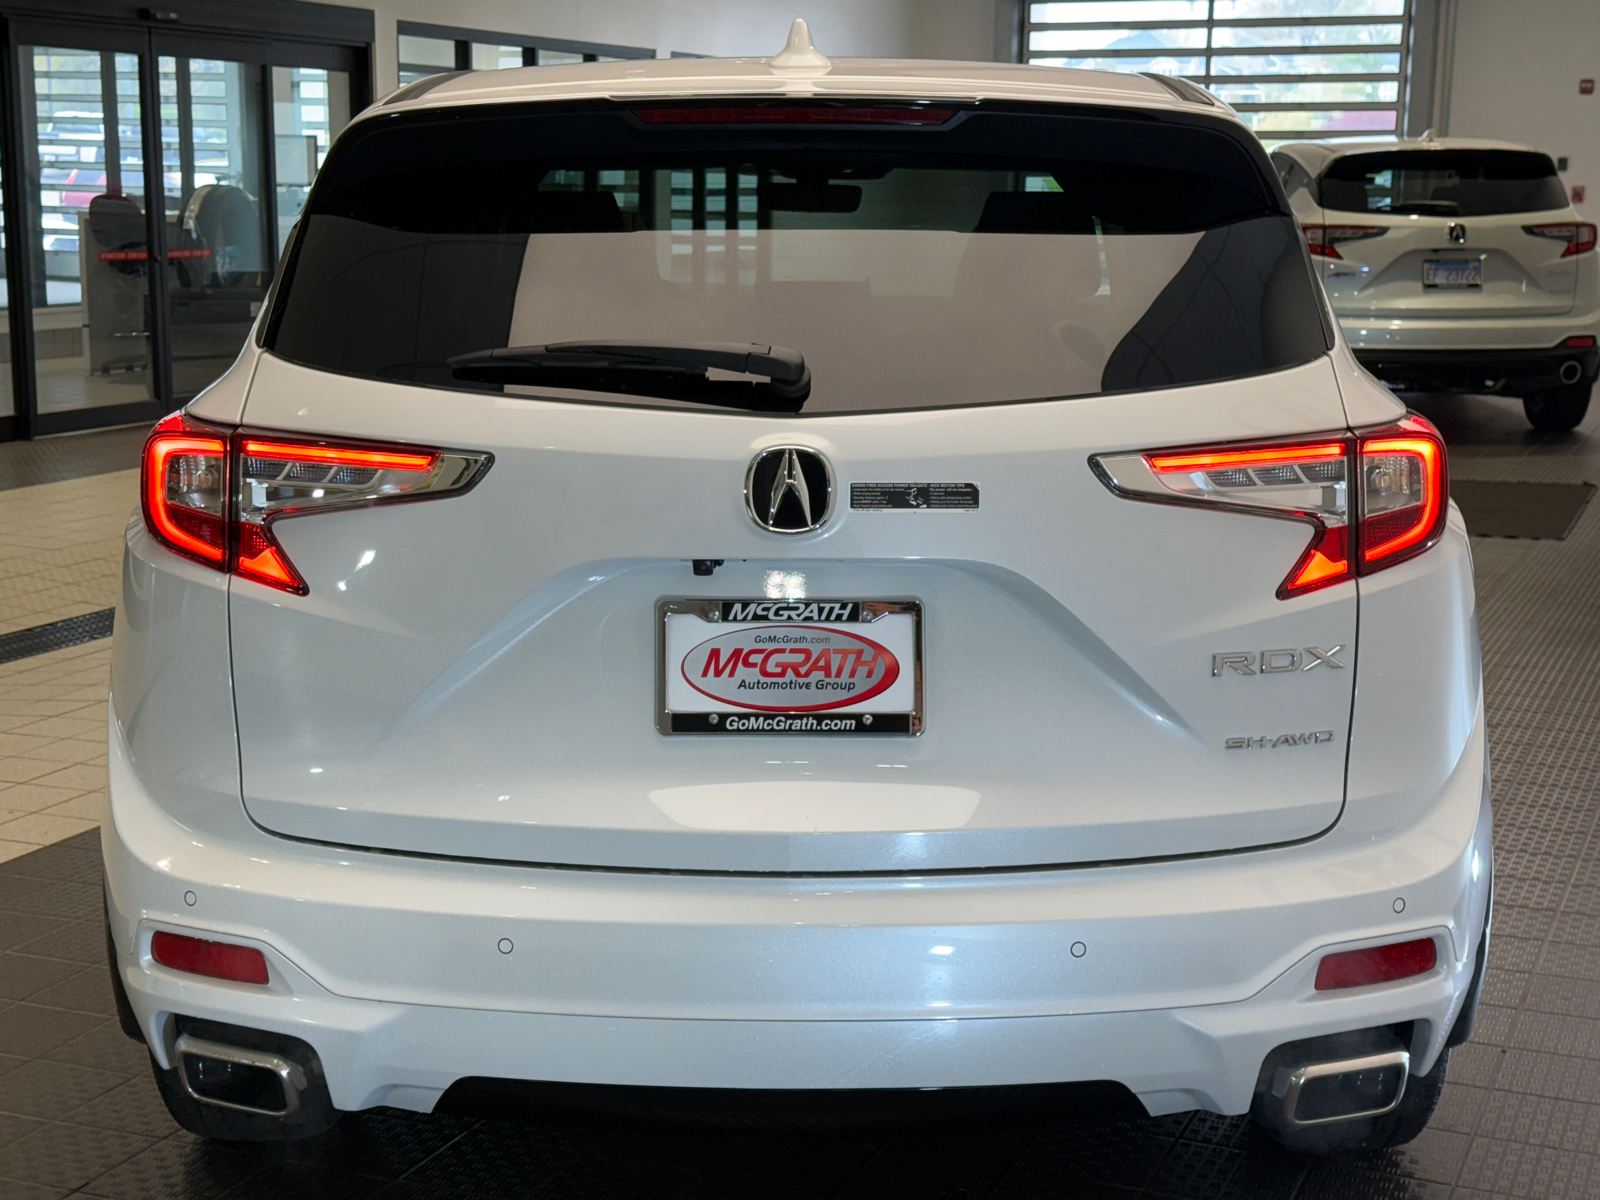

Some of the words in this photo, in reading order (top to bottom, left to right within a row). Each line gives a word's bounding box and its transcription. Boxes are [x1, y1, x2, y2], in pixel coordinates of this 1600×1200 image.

[754, 635, 831, 644] GoMcGrath.com
[1212, 644, 1346, 677] RDX
[737, 679, 811, 690] Automotive
[815, 679, 855, 693] Group
[725, 716, 856, 731] GoMcGrath.com
[1225, 730, 1335, 750] SH-AWD
